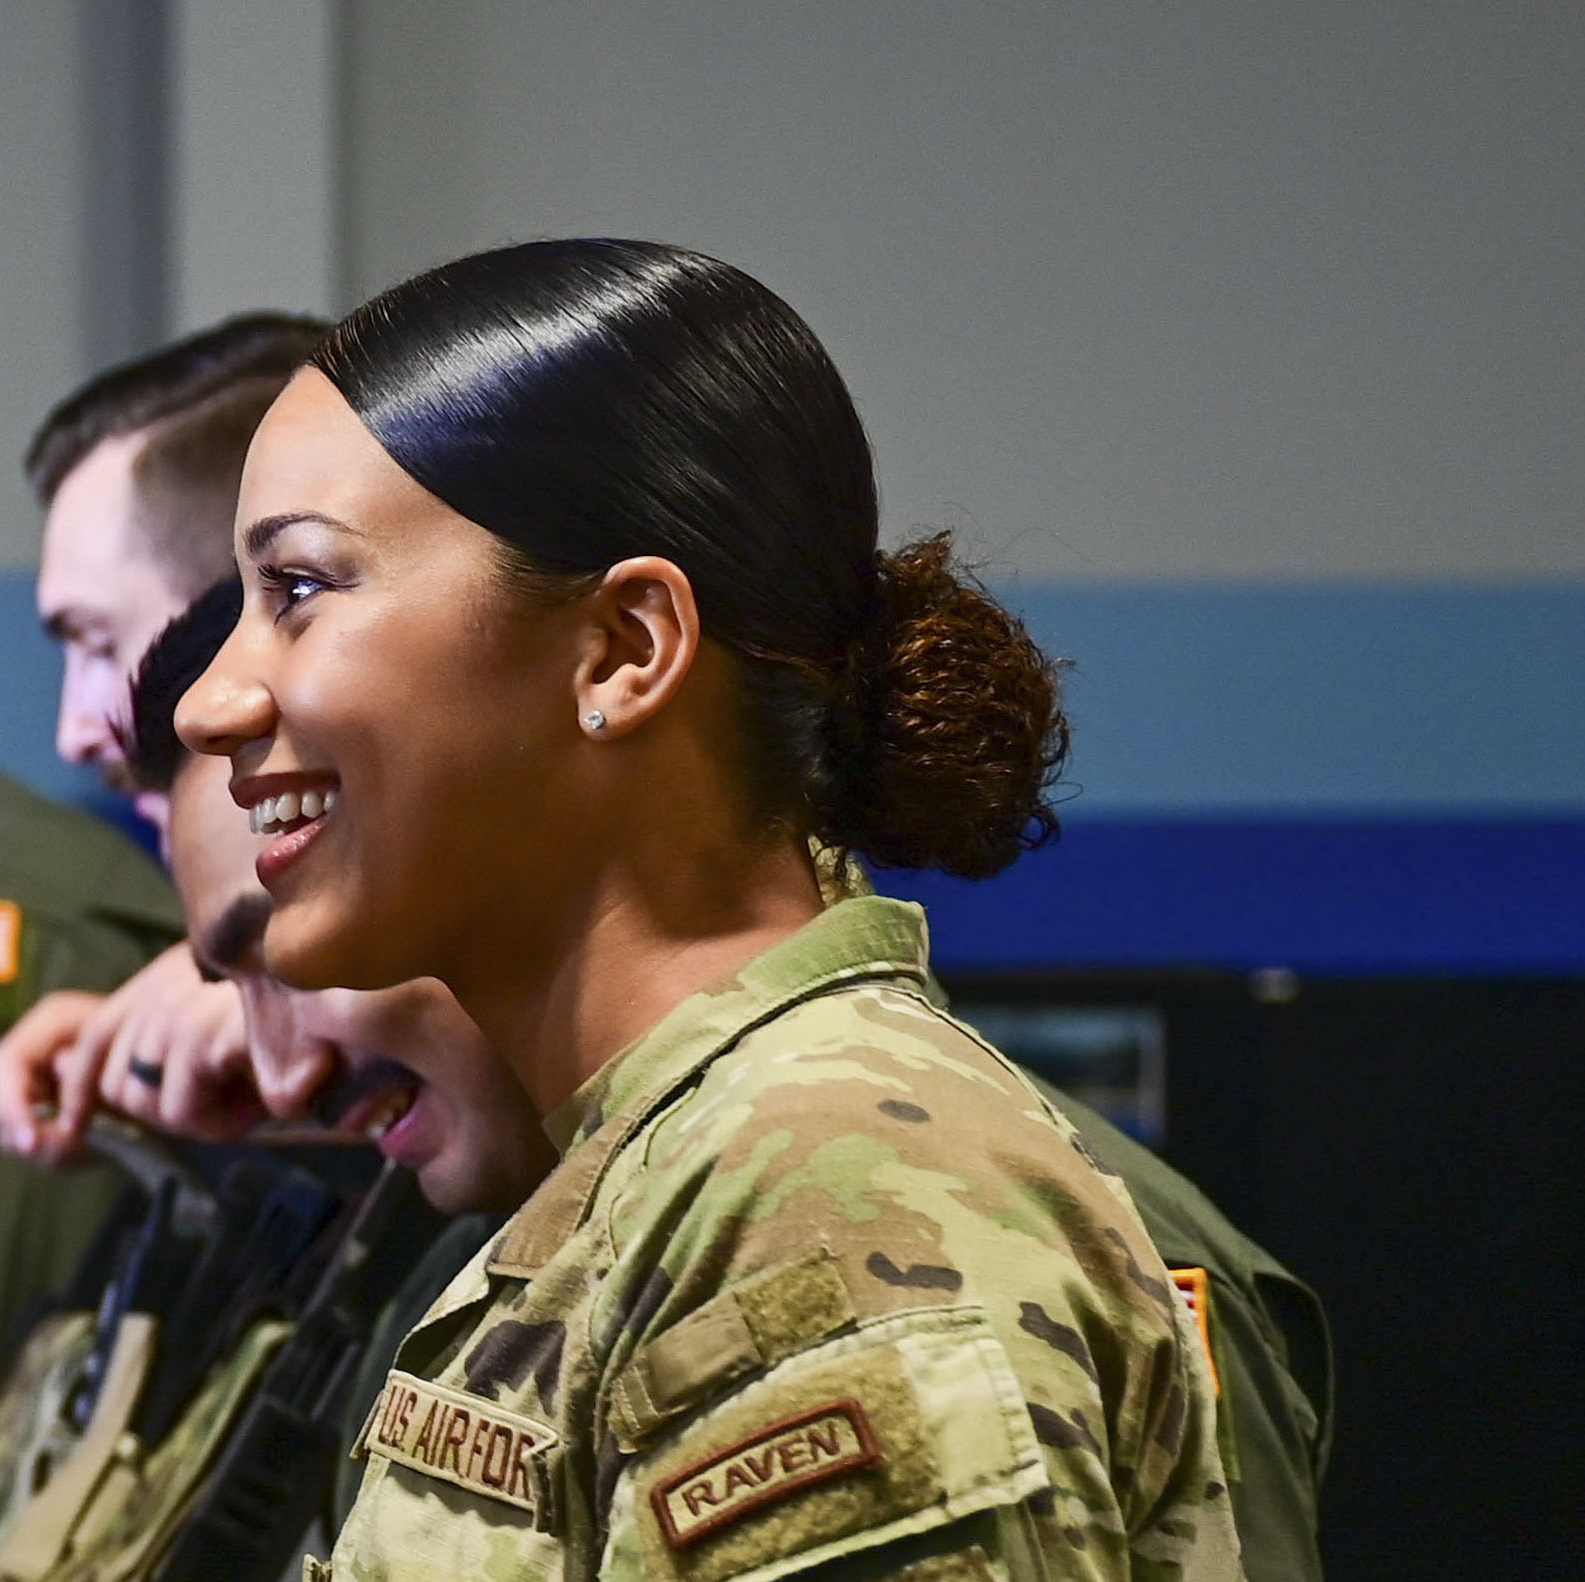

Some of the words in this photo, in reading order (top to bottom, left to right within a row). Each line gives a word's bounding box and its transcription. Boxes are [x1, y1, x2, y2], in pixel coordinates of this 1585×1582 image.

[412, 1399, 470, 1479] AIR
[466, 1418, 535, 1501] FOR
[682, 1421, 841, 1516] RAVEN
